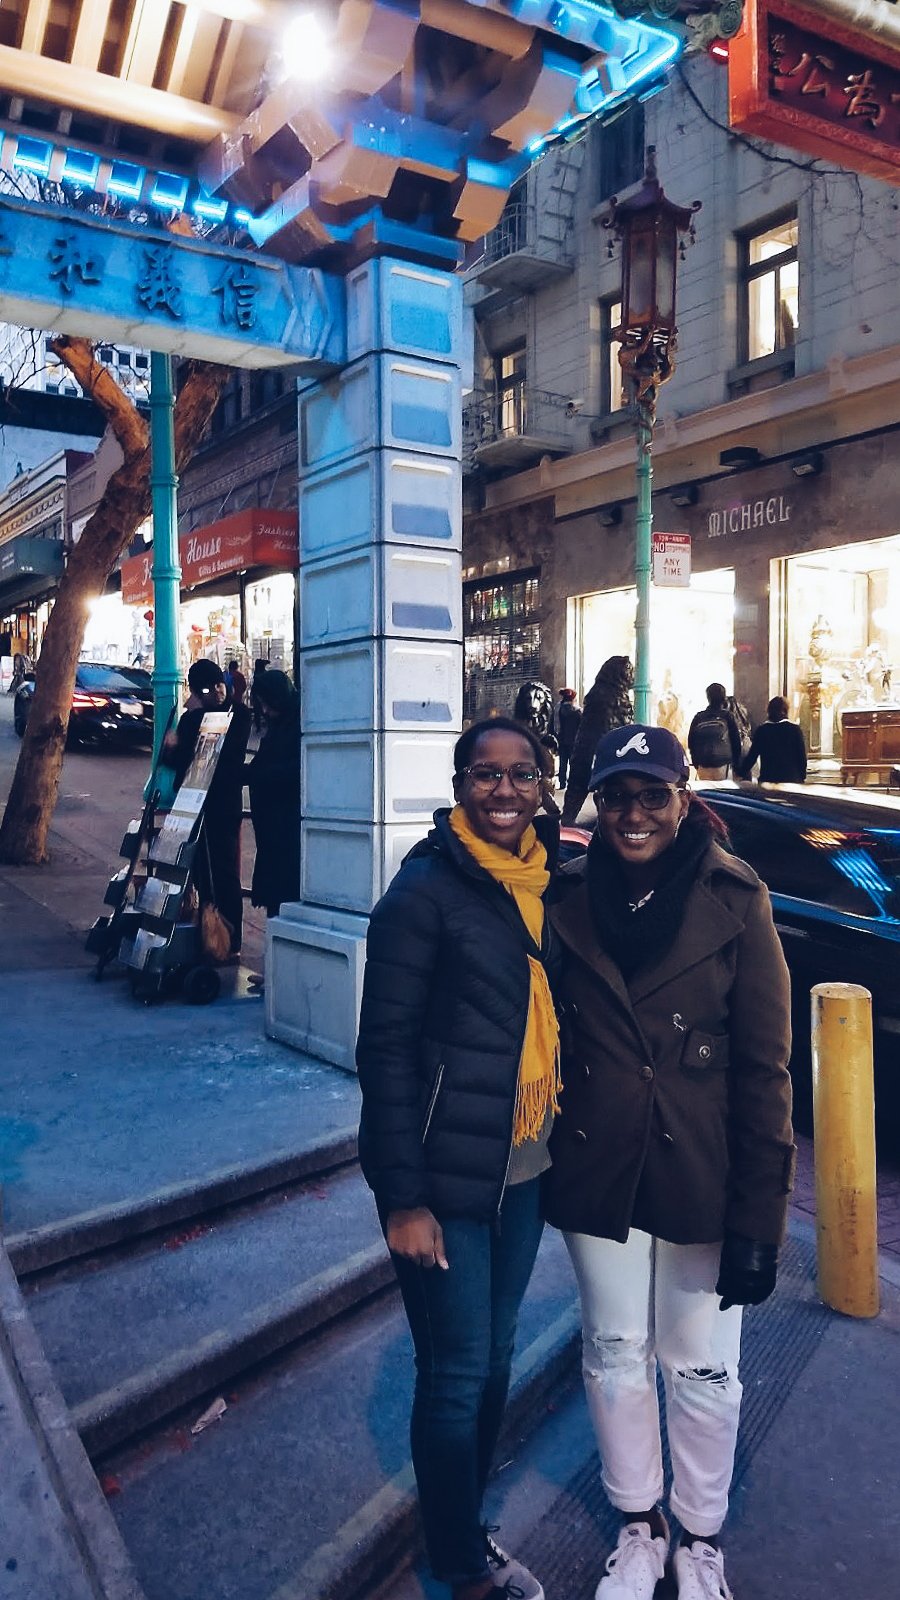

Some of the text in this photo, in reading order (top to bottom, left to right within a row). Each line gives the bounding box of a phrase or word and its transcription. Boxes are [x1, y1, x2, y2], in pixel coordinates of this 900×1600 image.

[707, 495, 791, 538] MICHAEL
[186, 536, 222, 565] House
[654, 542, 665, 552] NO
[664, 557, 681, 566] ANY
[662, 566, 682, 576] TIME
[616, 732, 650, 758] A
